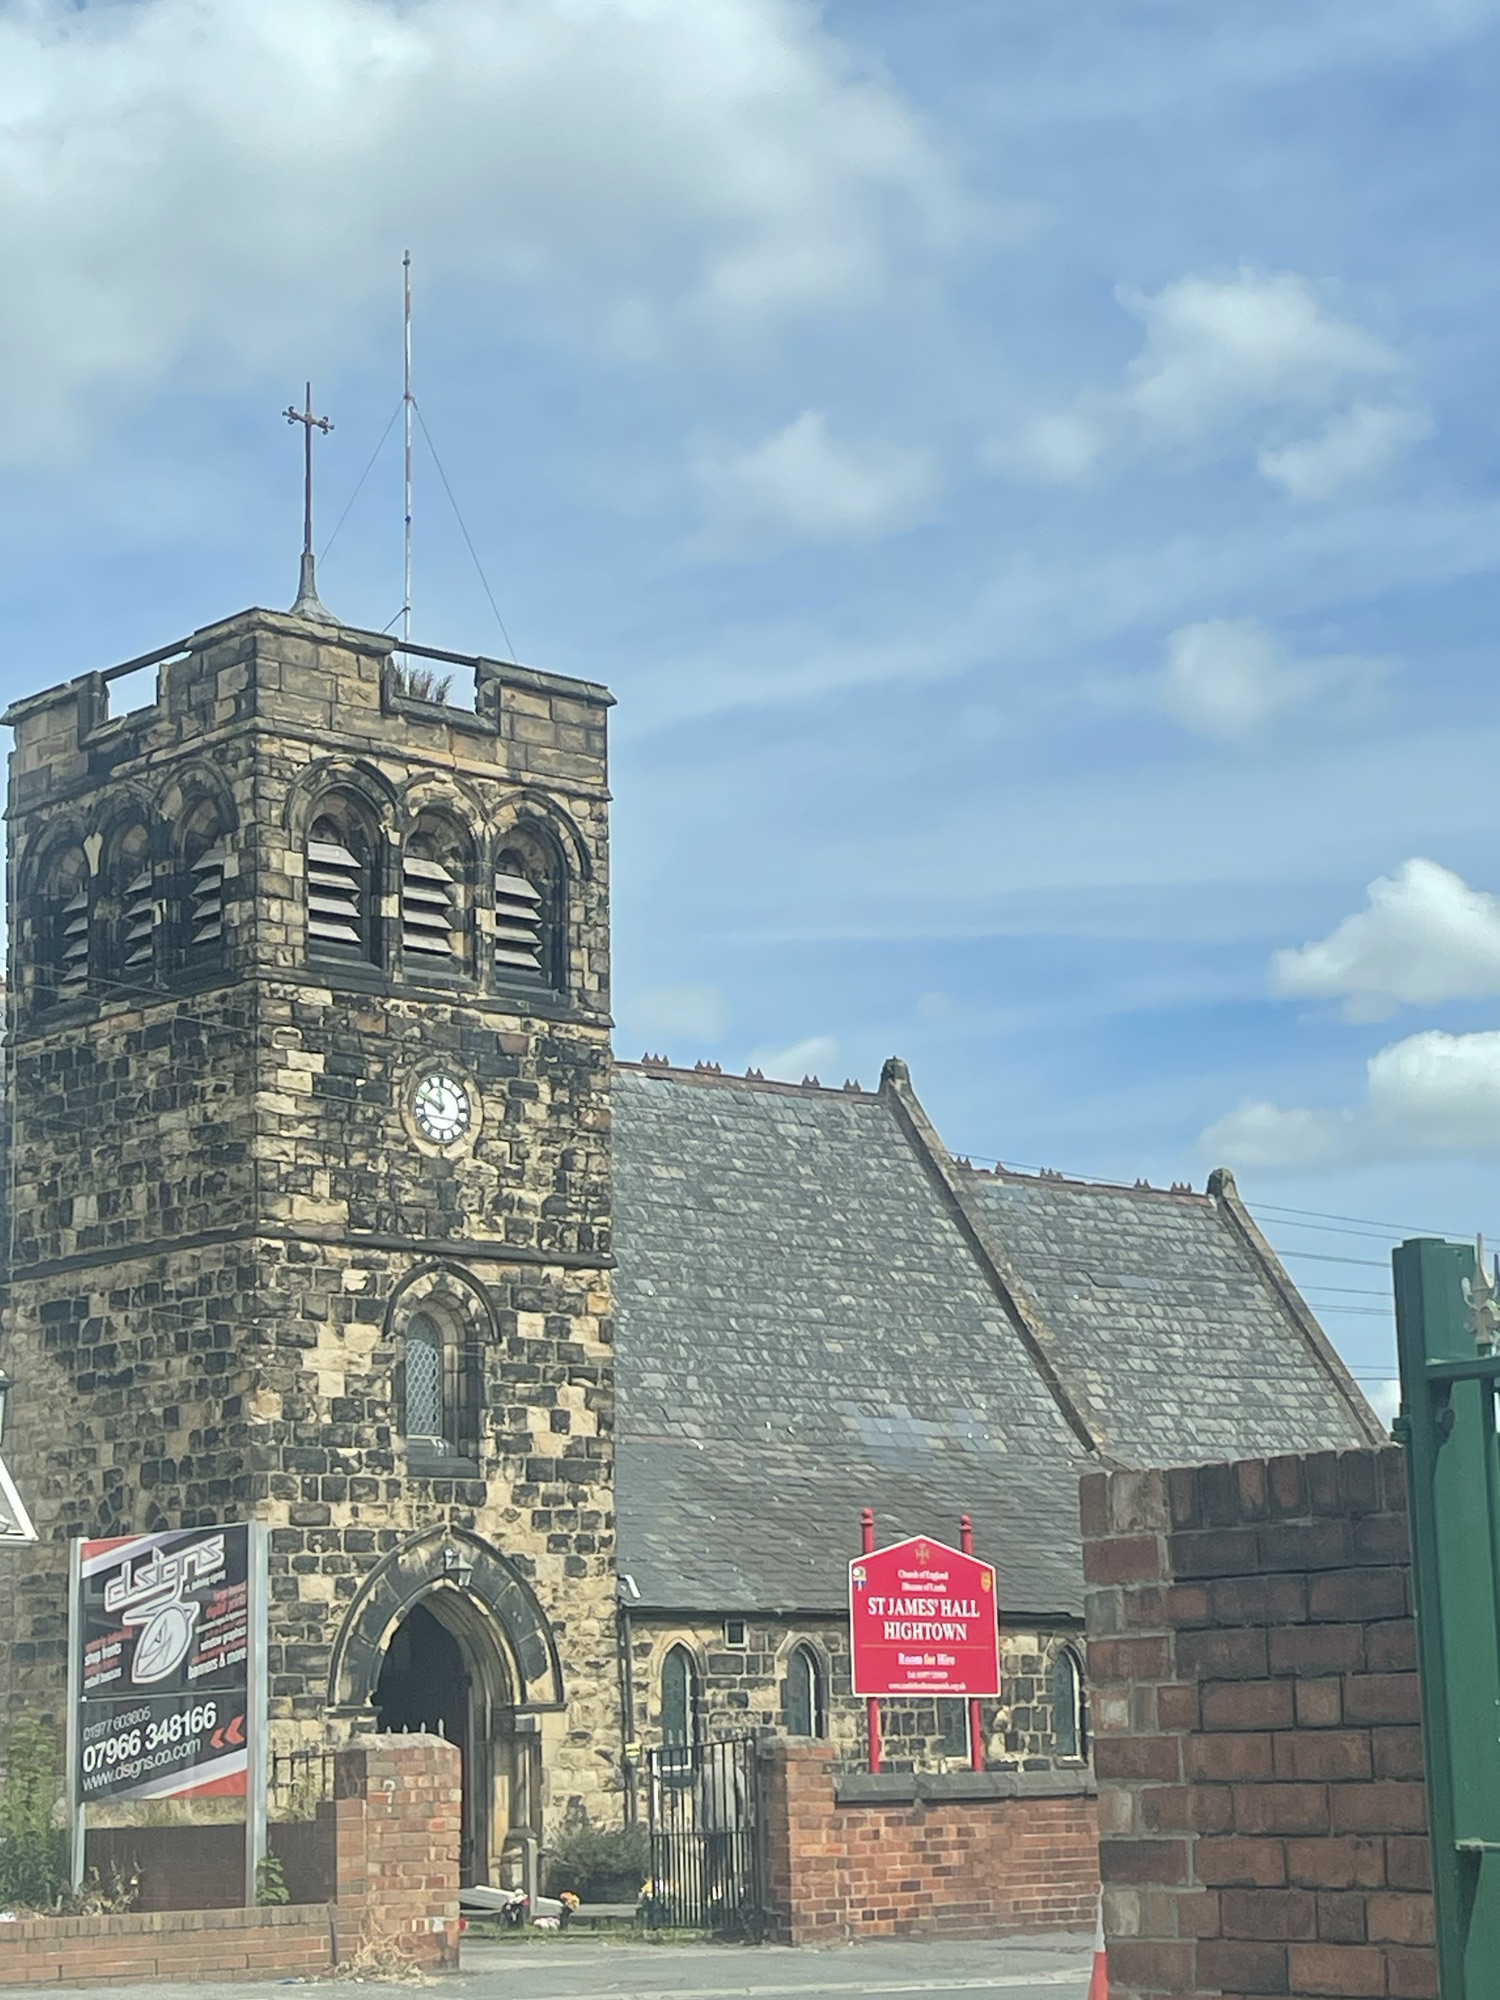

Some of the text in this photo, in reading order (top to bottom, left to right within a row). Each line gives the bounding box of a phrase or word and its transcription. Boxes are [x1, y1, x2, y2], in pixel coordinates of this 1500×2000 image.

[868, 1597, 980, 1617] ST JAMES' HALL
[883, 1621, 968, 1641] HIGHTOWN
[219, 1652, 226, 1668] &
[898, 1652, 956, 1666] Room for Hire
[83, 1702, 217, 1772] 07966 348166
